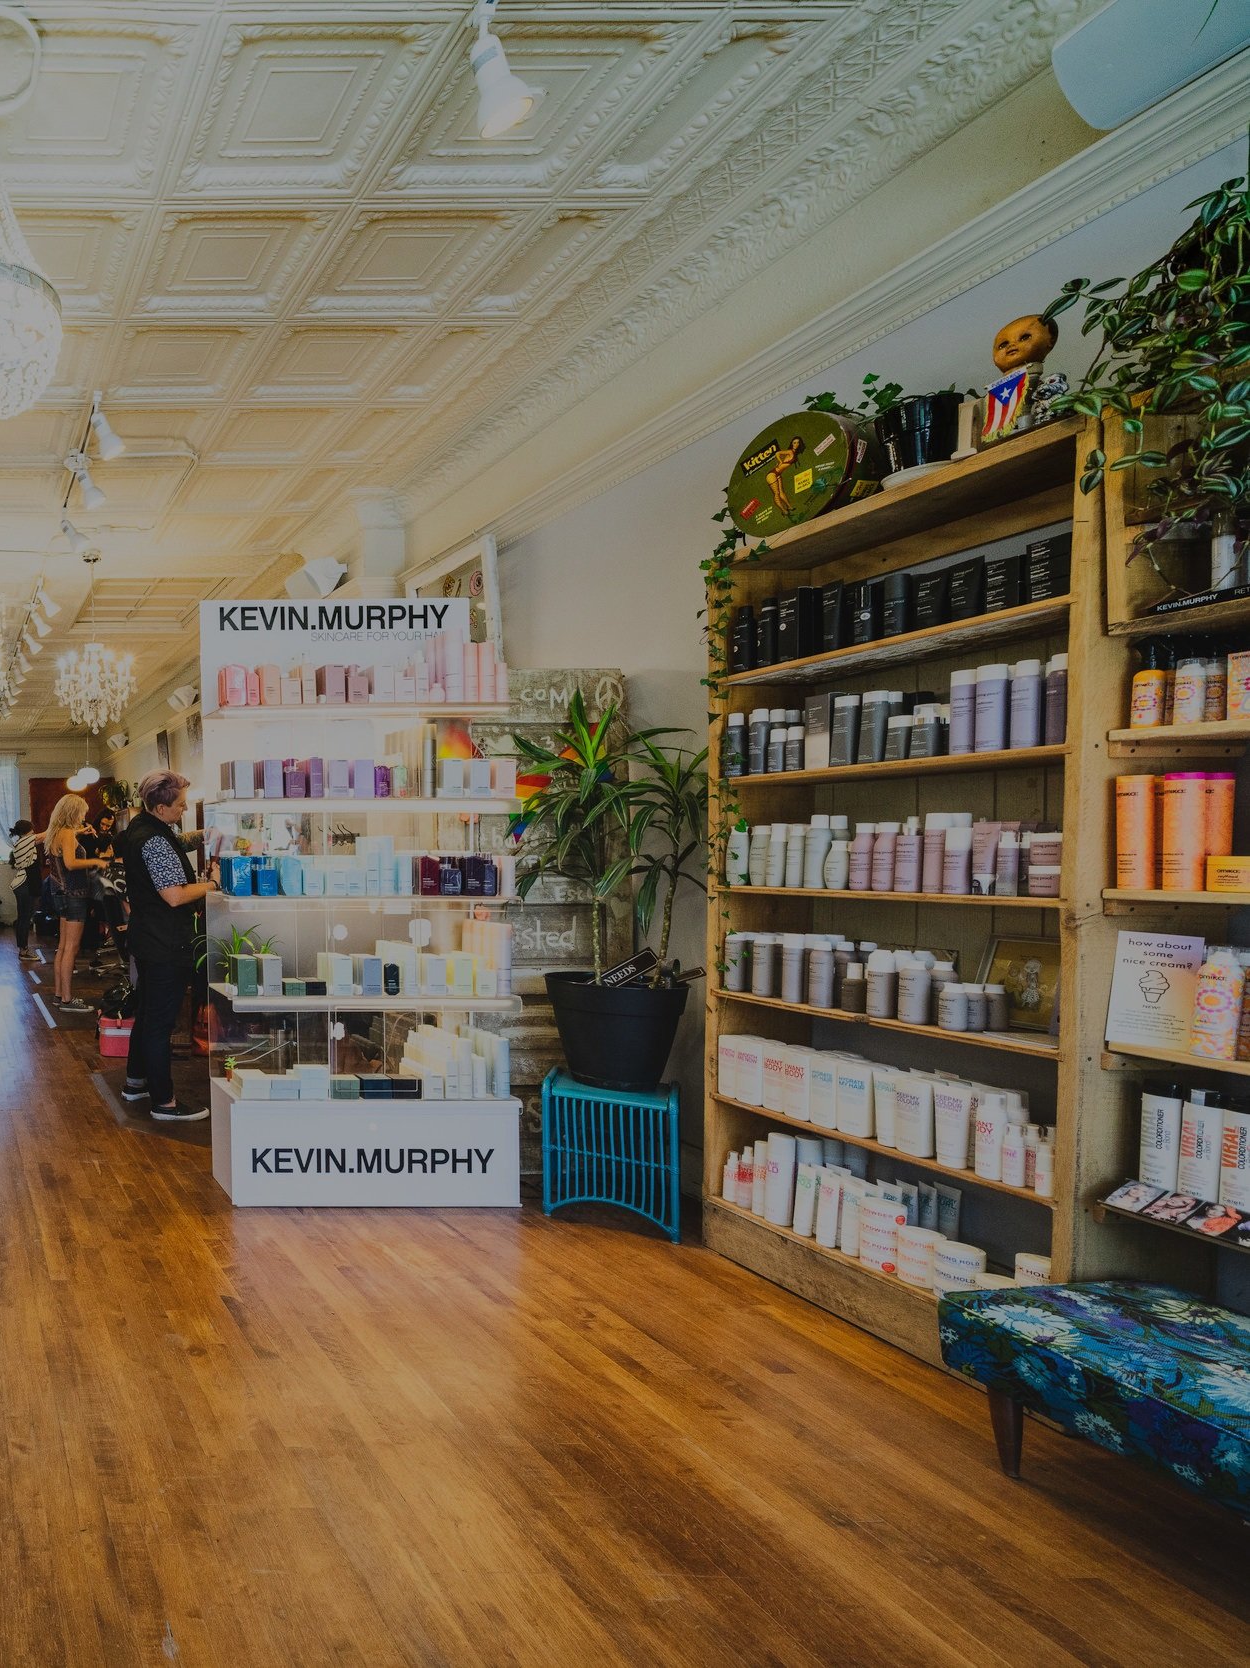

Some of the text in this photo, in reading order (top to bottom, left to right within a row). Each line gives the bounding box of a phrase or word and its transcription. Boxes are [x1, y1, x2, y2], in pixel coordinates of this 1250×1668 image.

[1157, 594, 1219, 611] KEVIN.MURPHY
[219, 604, 449, 631] KEVIN.MURPHY
[311, 632, 363, 642] SKINCARE
[367, 632, 389, 642] FOR
[391, 632, 421, 642] YOUR
[1128, 938, 1192, 951] how about
[1143, 950, 1174, 959] some
[1123, 958, 1193, 970] nice cream?
[603, 964, 637, 987] NEEDS
[765, 1063, 783, 1073] BODY
[785, 1069, 805, 1079] BODY
[787, 1064, 804, 1072] WANT
[838, 1075, 864, 1085] HYDRATE
[1156, 1109, 1164, 1149] COLORDITIONER
[1181, 1120, 1197, 1158] VIRAL
[1221, 1126, 1240, 1168] VIRAL
[1238, 1127, 1247, 1169] COLORDITIONER
[252, 1148, 494, 1174] KEVIN.MURPHY
[959, 1259, 980, 1267] HOLD
